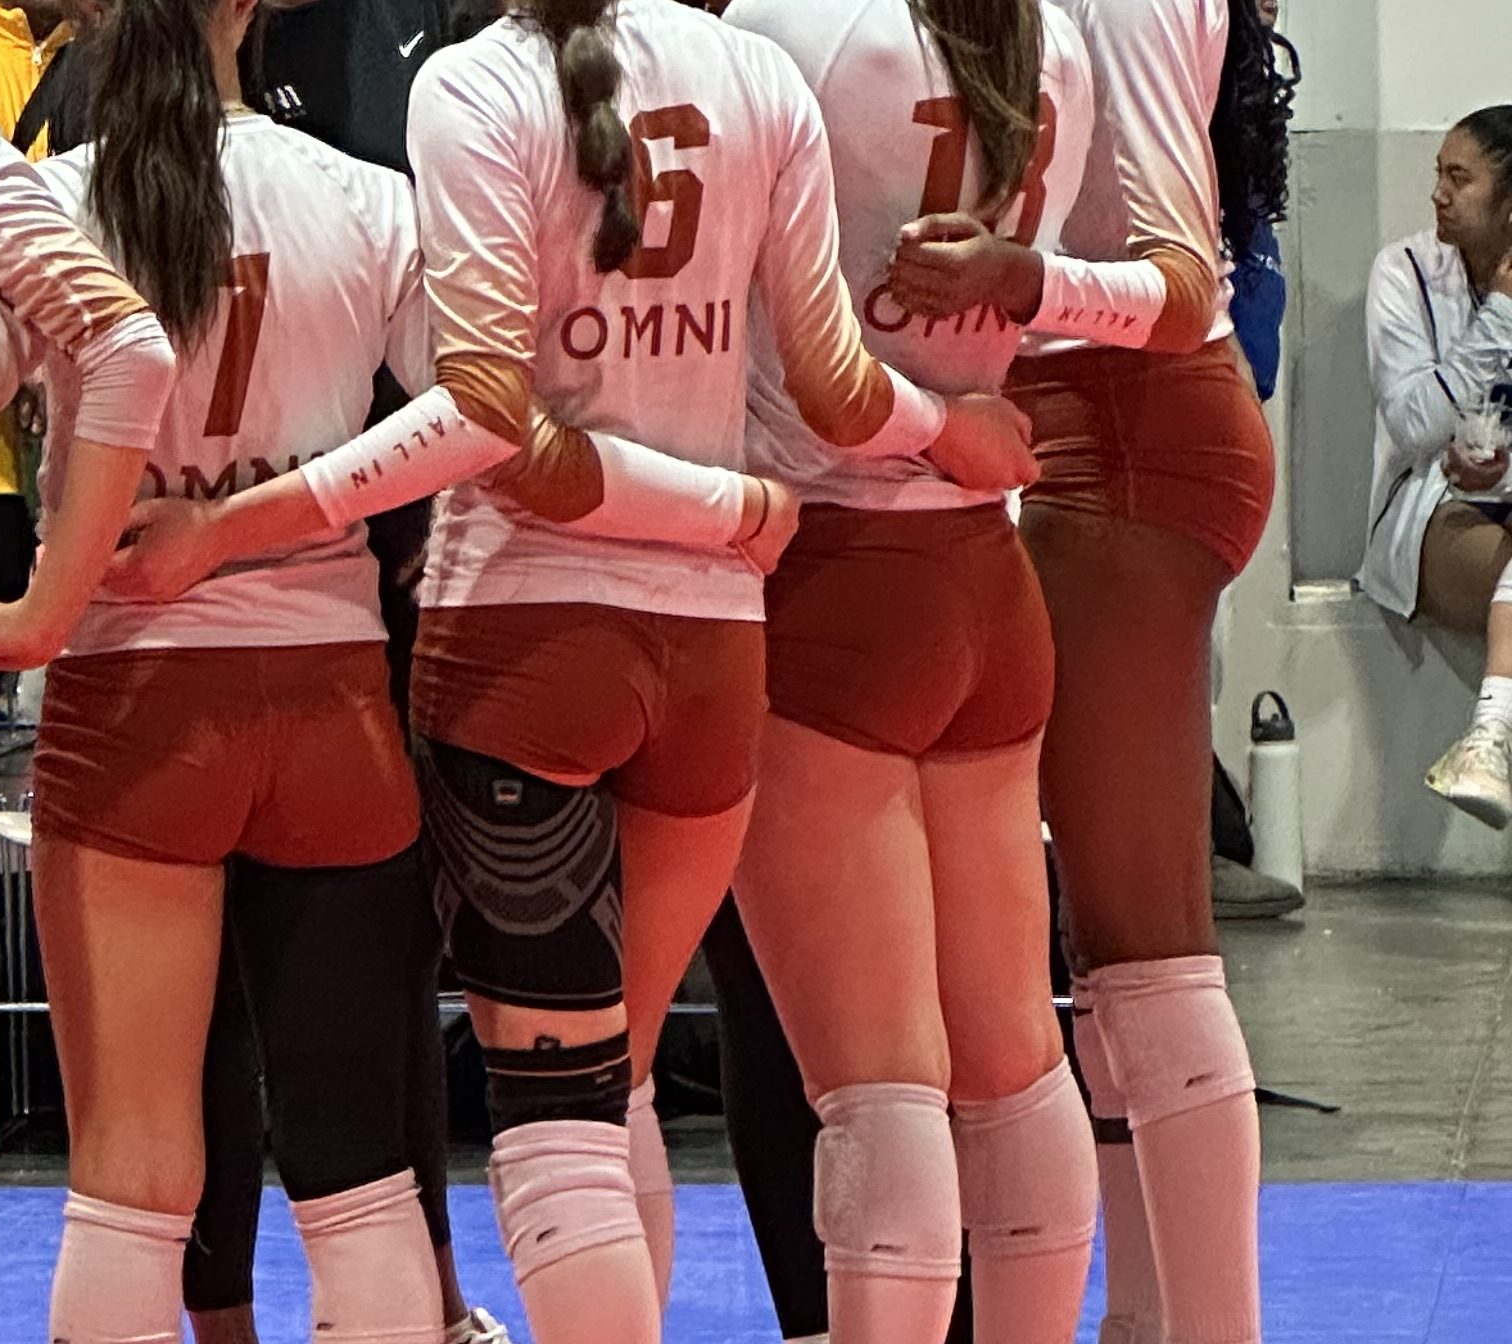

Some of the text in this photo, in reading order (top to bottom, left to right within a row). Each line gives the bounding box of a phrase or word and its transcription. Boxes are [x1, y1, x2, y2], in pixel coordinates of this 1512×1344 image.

[618, 103, 711, 280] 6
[560, 299, 731, 360] OMNI
[351, 416, 445, 490] ALL IN
